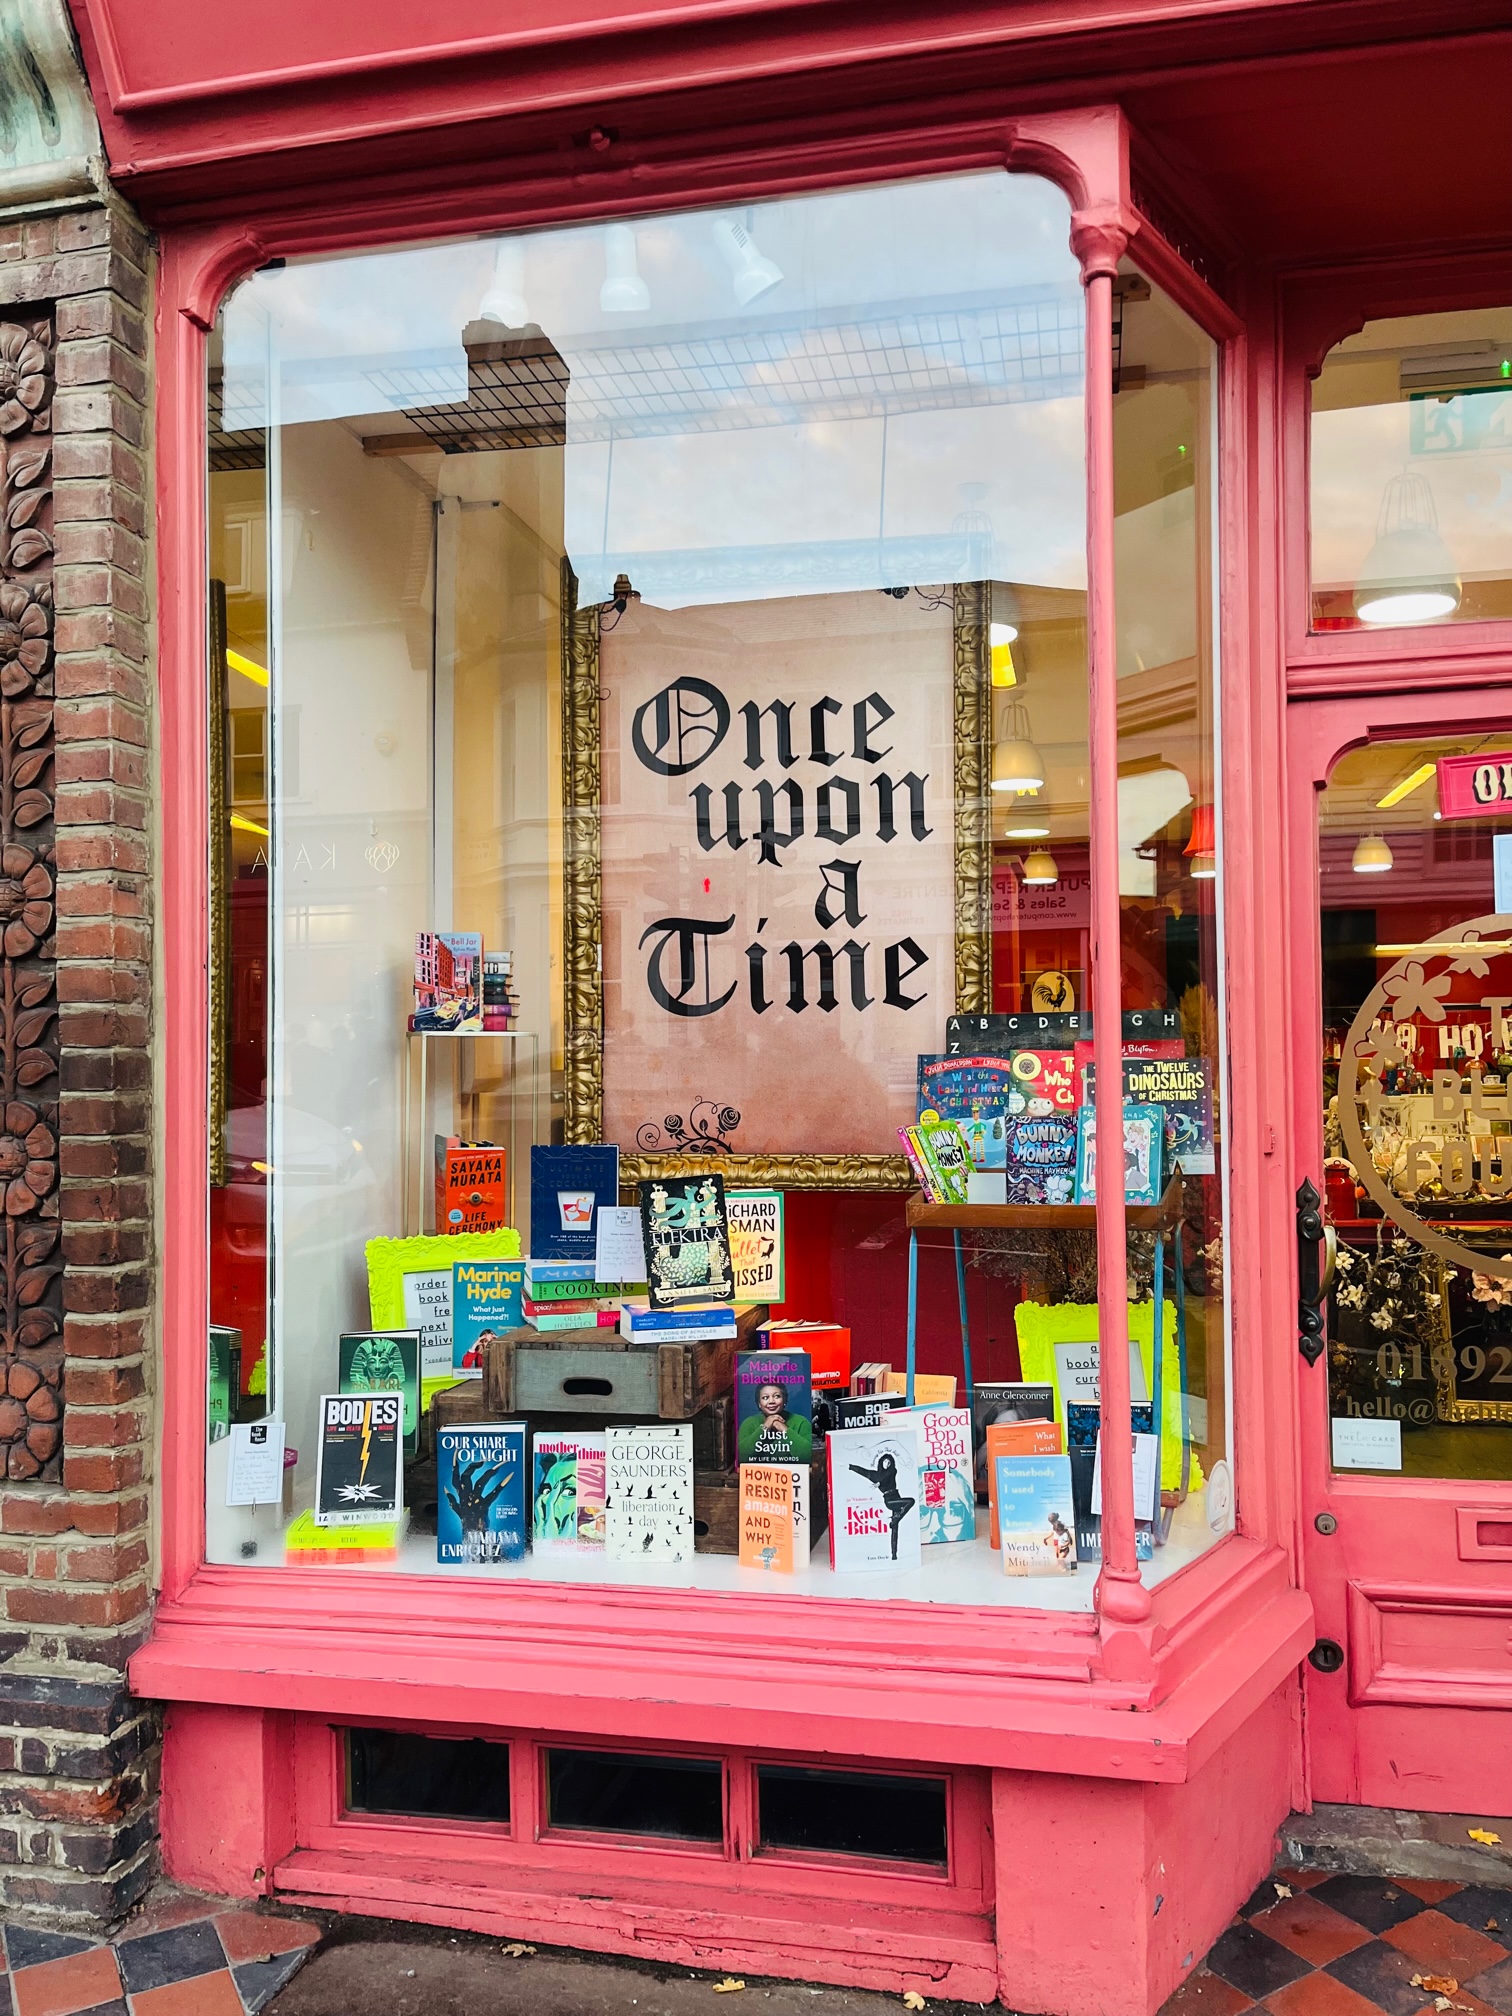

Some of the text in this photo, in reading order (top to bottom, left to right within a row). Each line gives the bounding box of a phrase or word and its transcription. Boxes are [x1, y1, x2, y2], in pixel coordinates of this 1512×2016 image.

[632, 676, 895, 776] Once
[689, 771, 934, 868] upon
[815, 858, 867, 930] a
[465, 938, 477, 946] Jar
[638, 913, 929, 1017] Time
[950, 1014, 1175, 1030] A B C D E G H
[950, 1043, 960, 1054] Z
[1143, 1061, 1189, 1073] THE TWELVE
[1044, 1069, 1071, 1085] Who
[1129, 1071, 1205, 1091] DINOSAURS
[950, 1095, 1005, 1107] CHRISTMAS
[1149, 1089, 1197, 1101] CHRISTMAS
[929, 1129, 958, 1152] BUNNY
[1016, 1125, 1074, 1145] BUNNY
[937, 1145, 964, 1167] MONKEY
[1017, 1144, 1073, 1164] MONKEY
[451, 1158, 501, 1175] SAYAKA
[450, 1171, 502, 1188] MURATA
[464, 1211, 487, 1224] LIFE
[448, 1220, 503, 1236] CEREMONY
[730, 1218, 775, 1233] SMAN
[652, 1227, 724, 1246] ELEKTRA
[731, 1239, 762, 1260] ullet
[458, 1266, 522, 1283] Marina
[734, 1264, 773, 1288] ISSED
[414, 1278, 447, 1290] order
[554, 1282, 635, 1297] COOKING
[702, 1285, 727, 1293] SAINT
[419, 1292, 449, 1304] book
[467, 1283, 512, 1303] Hyde
[473, 1305, 505, 1314] What Just
[468, 1313, 509, 1323] Happened?!
[421, 1321, 448, 1332] next
[749, 1360, 798, 1372] Malorie
[1376, 1343, 1512, 1384] 01892
[370, 1378, 402, 1390] EARL
[741, 1372, 805, 1385] Blackman
[980, 1390, 1049, 1400] Anne Glenconner
[327, 1399, 397, 1426] BODIES
[865, 1402, 891, 1415] BOB
[923, 1410, 970, 1429] Good
[759, 1429, 788, 1441] Just
[924, 1428, 957, 1447] Pop
[1035, 1432, 1056, 1441] What
[441, 1436, 508, 1450] OUR SHARE
[539, 1441, 579, 1454] mother
[931, 1440, 965, 1457] Bad
[1038, 1443, 1056, 1453] wish
[458, 1449, 518, 1463] OF NIGHT
[612, 1445, 685, 1461] GEORGE
[610, 1464, 687, 1478] SAUNDERS
[925, 1456, 958, 1474] Pop
[745, 1469, 788, 1485] HOW TO
[1003, 1467, 1056, 1480] Somebody
[745, 1483, 788, 1502] RESIST
[1011, 1485, 1034, 1494] used
[622, 1500, 676, 1513] liberation
[744, 1499, 788, 1517] amazon
[1005, 1503, 1015, 1511] to
[638, 1515, 659, 1530] day
[746, 1515, 771, 1529] AND
[847, 1505, 884, 1525] Kate
[847, 1519, 888, 1536] Bush
[1006, 1518, 1032, 1528] know
[746, 1531, 771, 1545] WHY
[1007, 1541, 1041, 1555] Wendy
